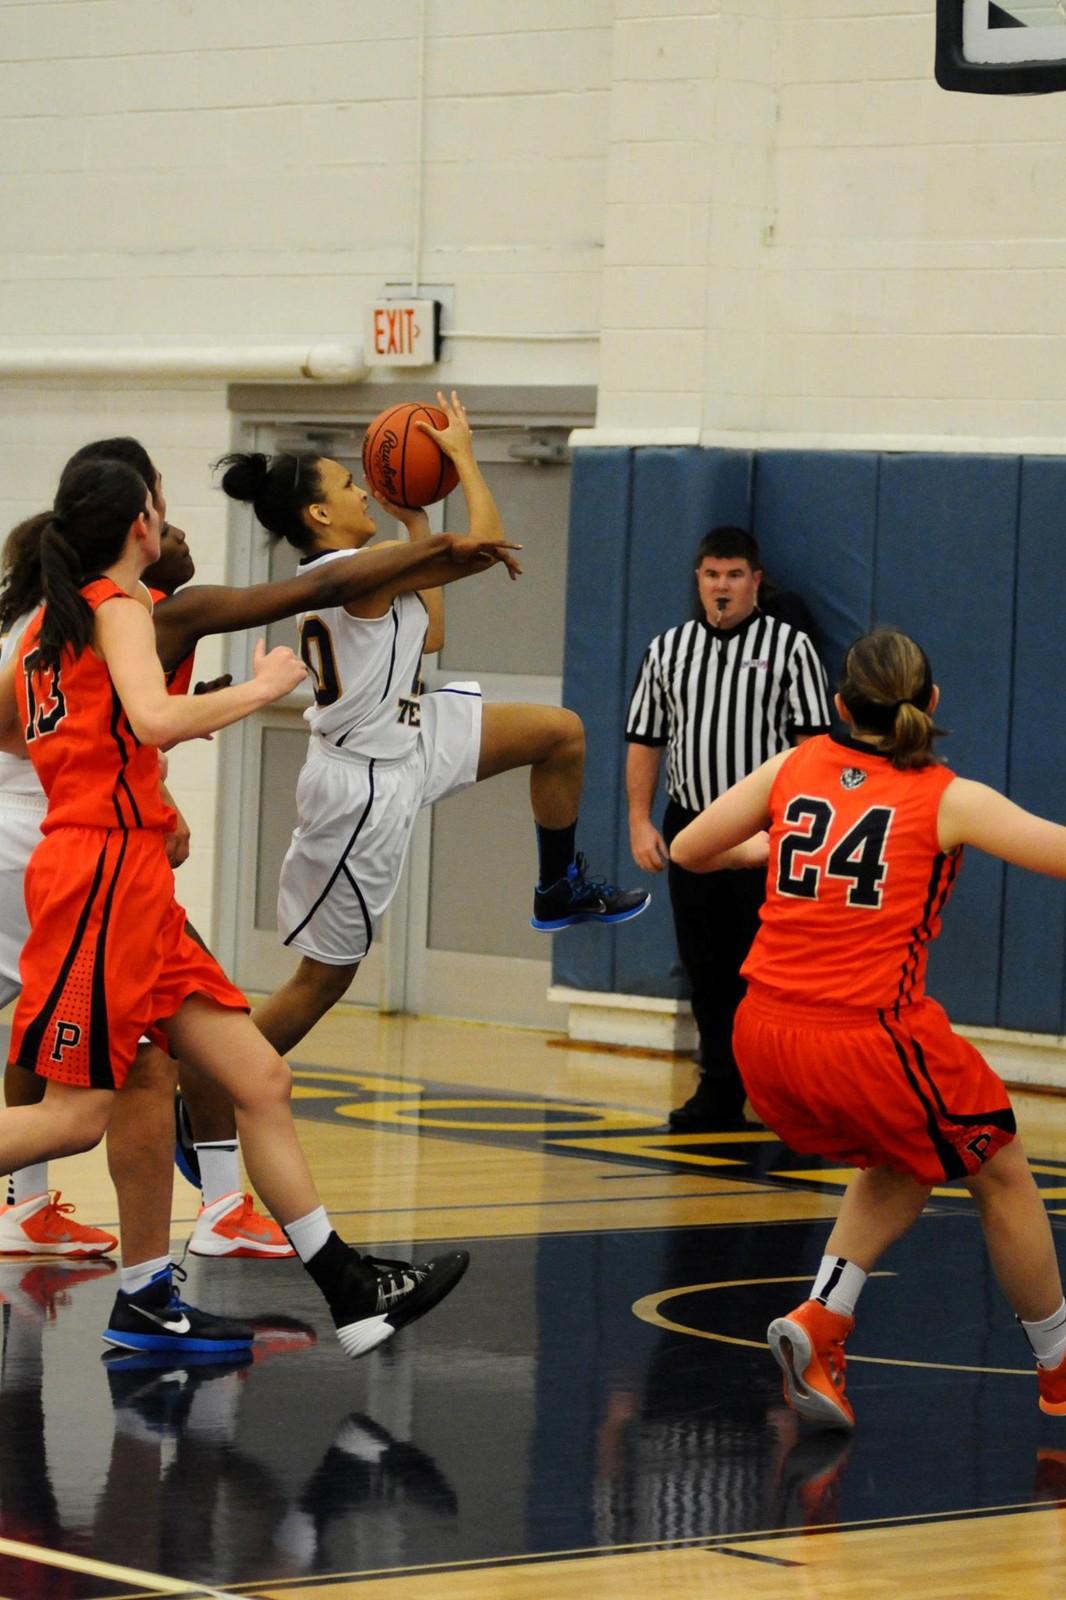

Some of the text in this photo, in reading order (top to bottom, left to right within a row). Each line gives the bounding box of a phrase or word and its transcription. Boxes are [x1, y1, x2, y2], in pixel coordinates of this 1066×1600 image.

[374, 309, 415, 354] EXIT
[23, 646, 68, 744] 13
[776, 794, 896, 910] 24
[50, 1019, 82, 1062] P
[964, 1131, 993, 1165] P
